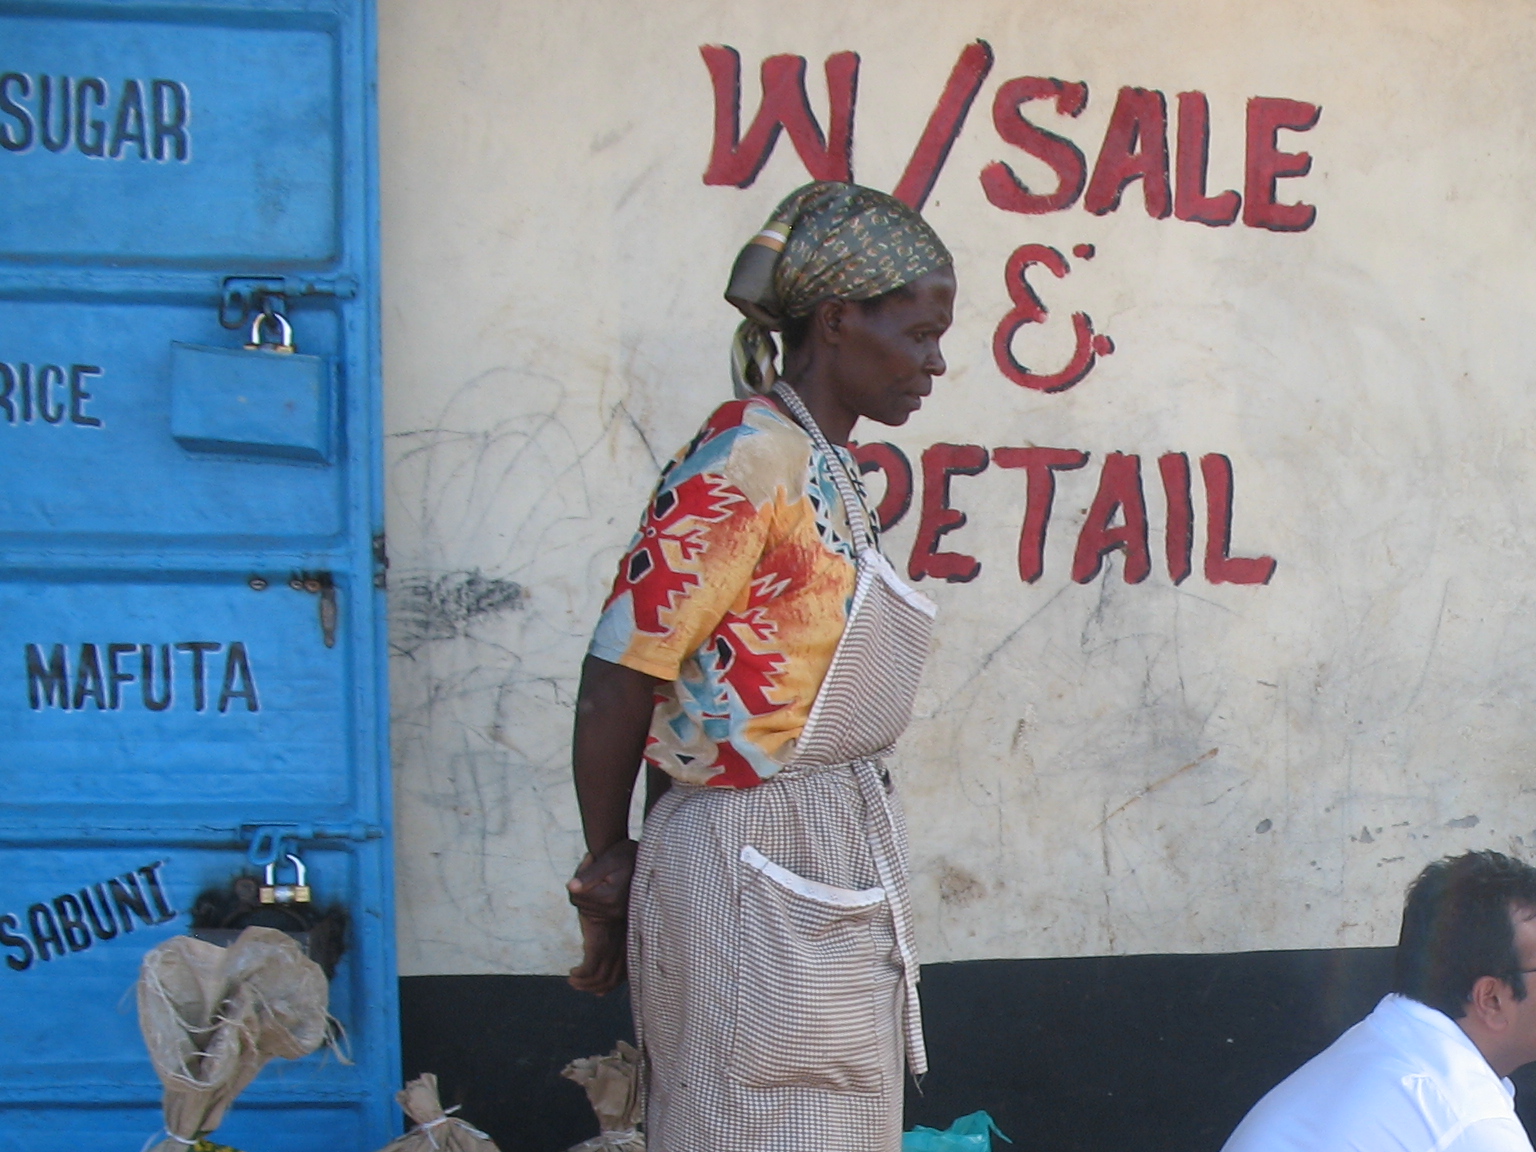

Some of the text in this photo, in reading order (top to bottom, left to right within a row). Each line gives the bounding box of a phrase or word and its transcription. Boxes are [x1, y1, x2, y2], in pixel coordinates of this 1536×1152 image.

[0, 72, 191, 164] SUGAR
[699, 38, 1322, 232] W/SALE
[993, 243, 1115, 393] &
[0, 362, 105, 430] RICE
[25, 640, 260, 714] MAFUTA
[0, 858, 178, 973] SABUNI
